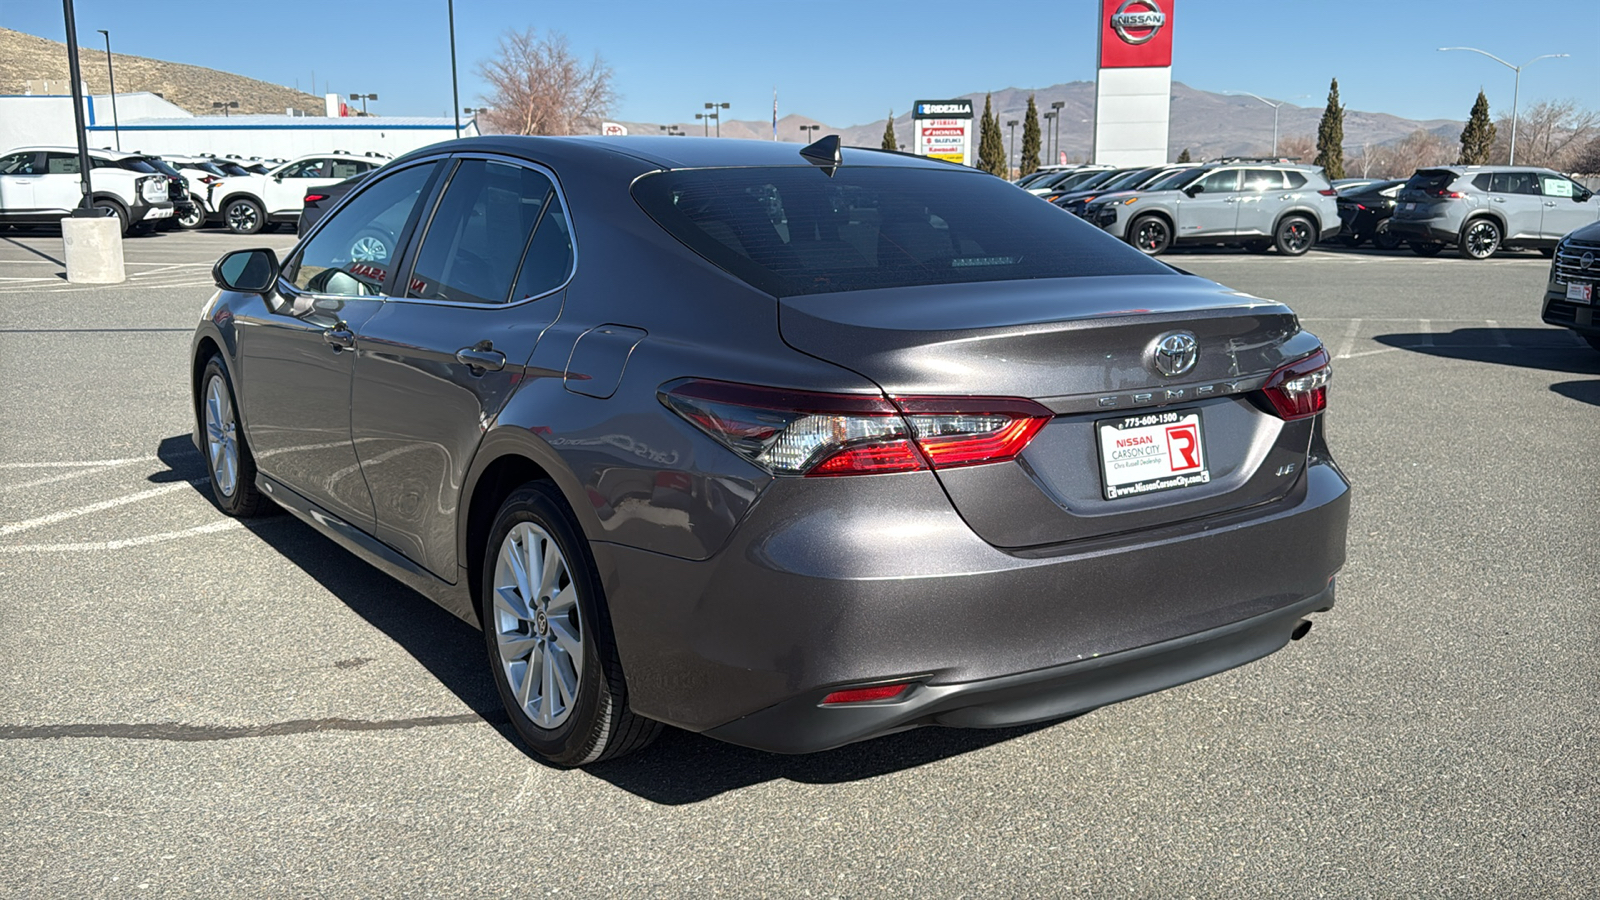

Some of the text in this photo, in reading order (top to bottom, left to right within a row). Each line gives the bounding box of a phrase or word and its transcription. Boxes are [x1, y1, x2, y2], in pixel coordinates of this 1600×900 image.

[1117, 15, 1161, 24] NISSAN
[931, 104, 971, 114] RIDEZILLA
[1124, 412, 1178, 428] 775-600-1500
[1116, 435, 1153, 449] NISSAN
[1112, 444, 1160, 460] CARSON CITY
